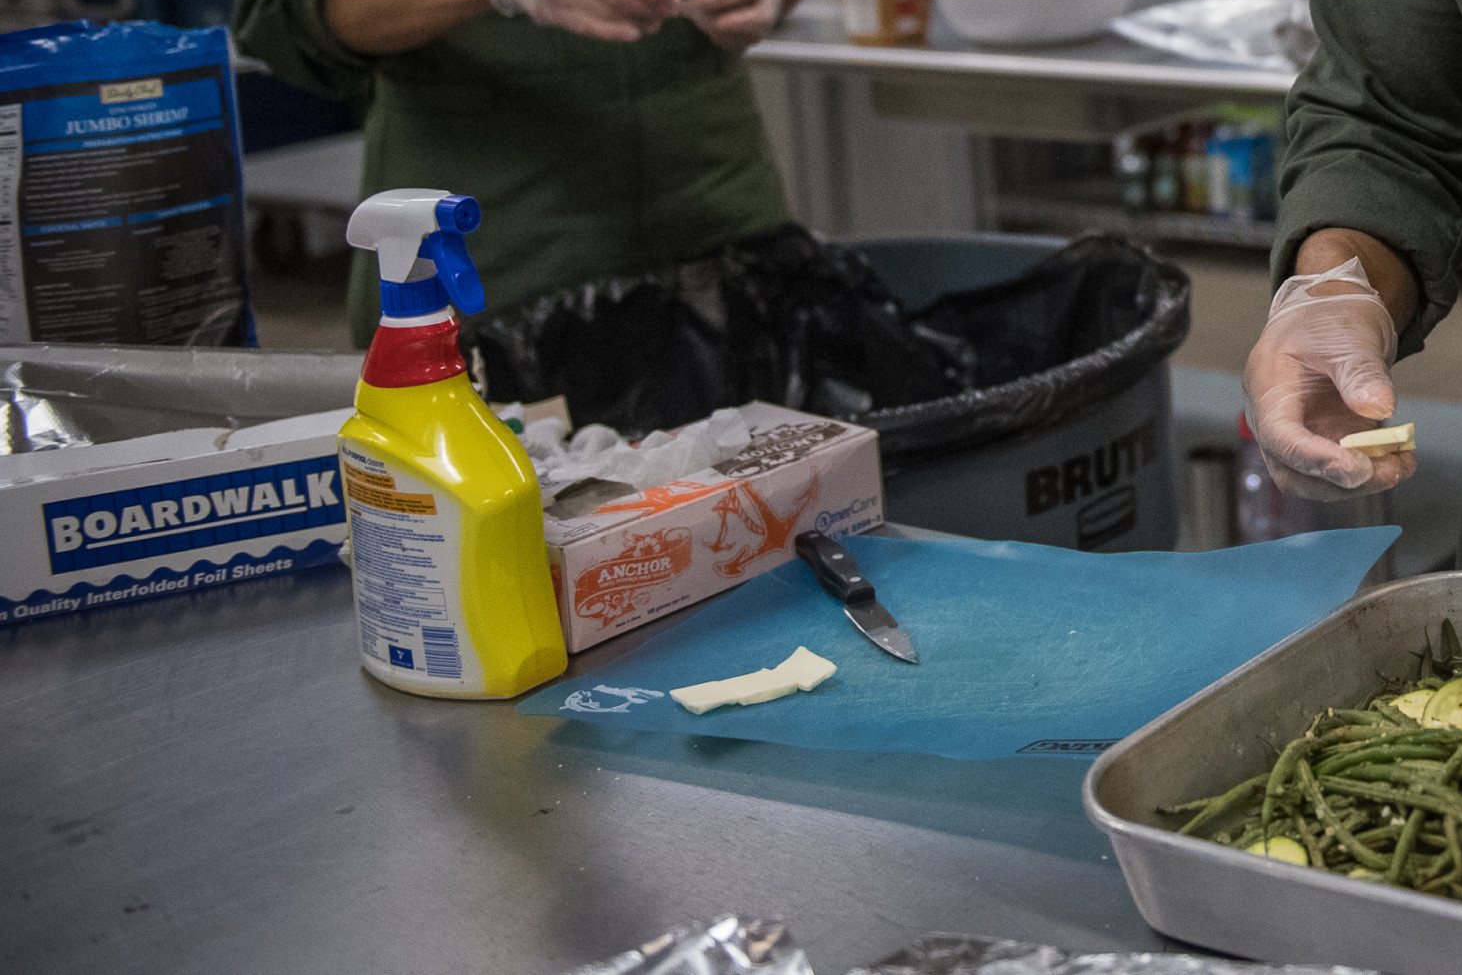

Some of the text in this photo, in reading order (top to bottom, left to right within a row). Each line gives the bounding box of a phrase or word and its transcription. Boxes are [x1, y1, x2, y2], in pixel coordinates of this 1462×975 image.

[65, 115, 131, 136] JUMBO
[51, 470, 340, 554] BOARDWALK
[14, 596, 81, 619] Quality
[87, 576, 189, 605] Interfolded
[194, 568, 227, 586] Foil
[231, 558, 293, 579] Sheets
[598, 556, 672, 583] ANCHOR
